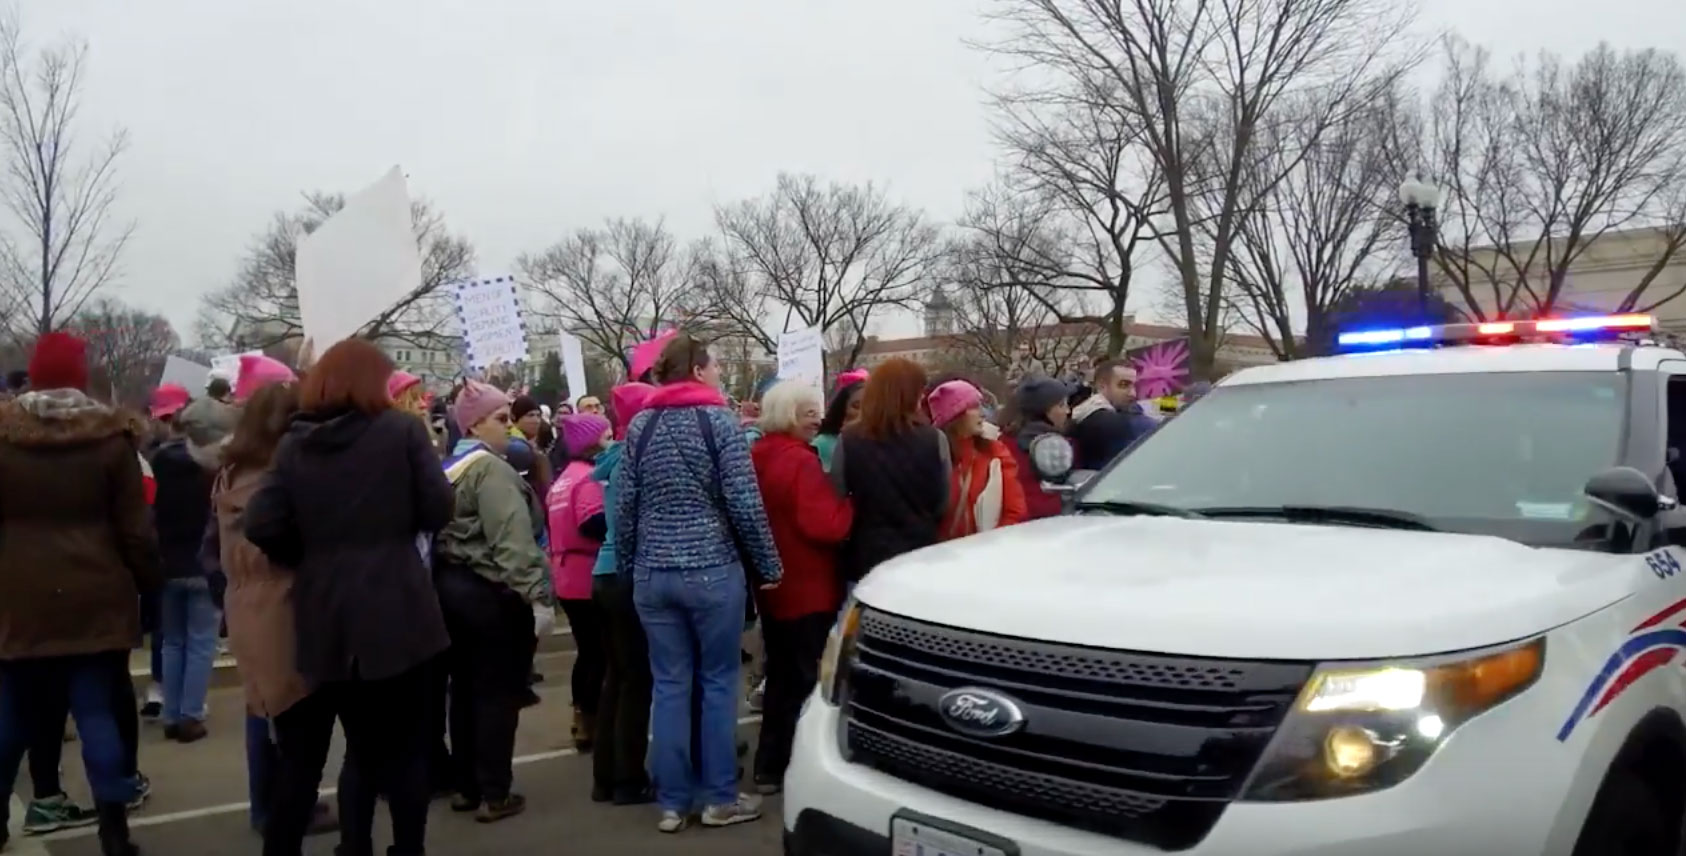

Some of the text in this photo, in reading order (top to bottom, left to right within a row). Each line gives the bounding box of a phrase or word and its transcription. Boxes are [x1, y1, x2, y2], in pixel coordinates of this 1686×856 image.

[464, 293, 490, 305] MEN
[470, 315, 510, 332] DEMAND
[1645, 549, 1682, 580] 654
[949, 694, 999, 727] Ford
